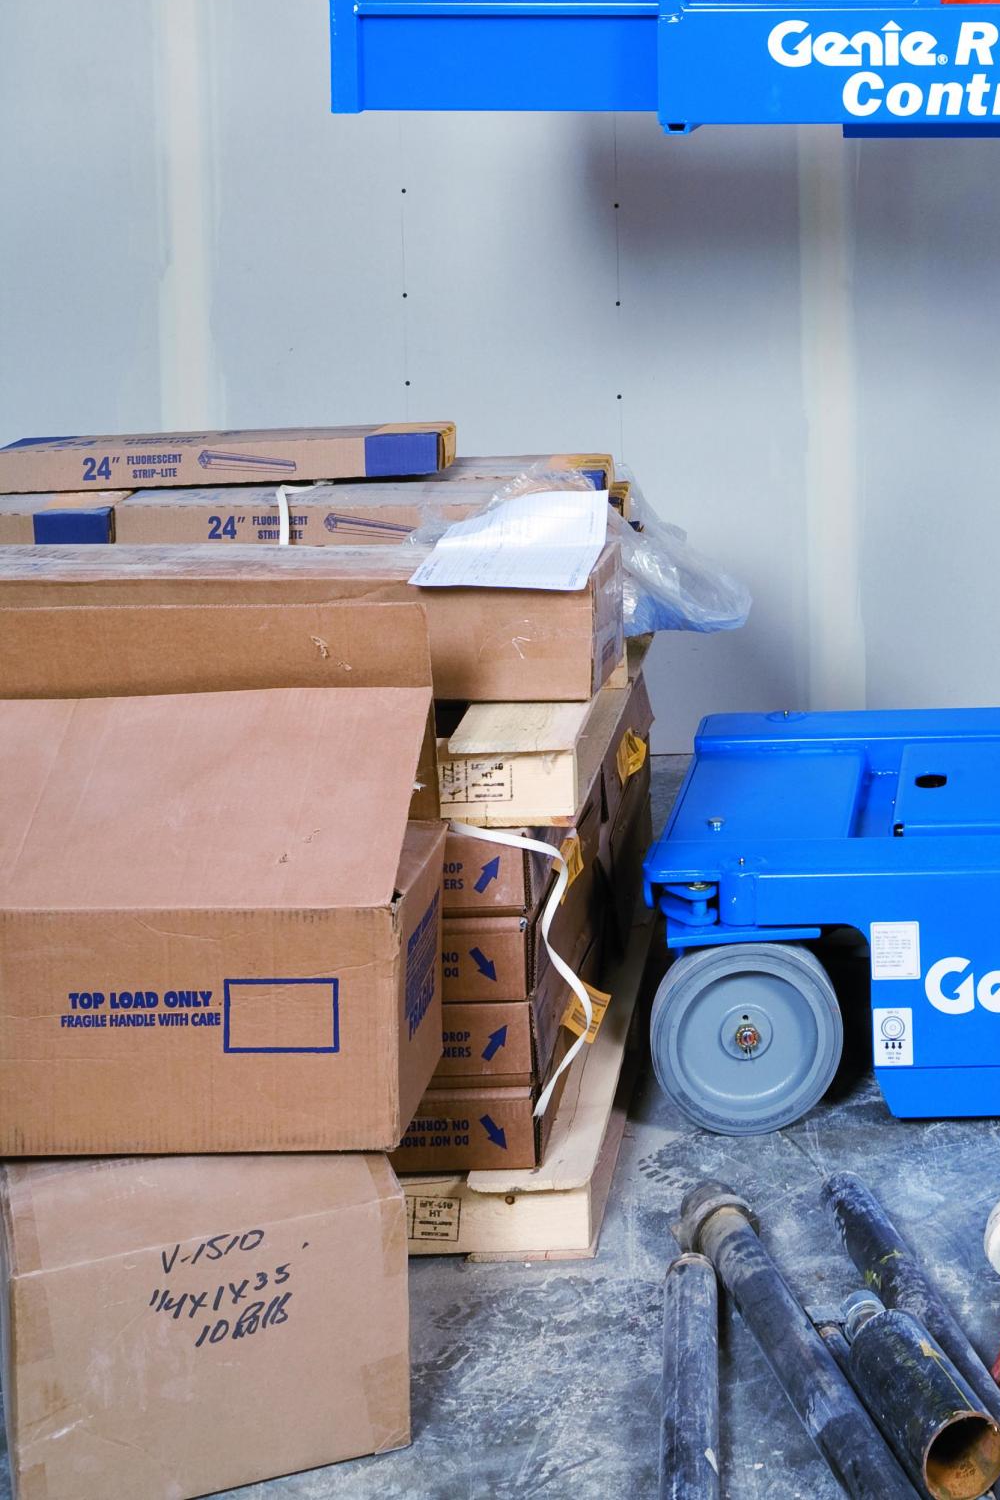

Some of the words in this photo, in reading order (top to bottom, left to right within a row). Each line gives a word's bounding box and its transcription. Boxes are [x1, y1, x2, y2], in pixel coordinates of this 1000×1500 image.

[126, 453, 183, 466] FLUORESCENT
[132, 467, 178, 479] STRIP-LITE
[68, 992, 105, 1009] TOP
[109, 991, 159, 1009] LOAD
[163, 990, 213, 1008] ONLY
[60, 1014, 107, 1028] FRAGILE
[109, 1013, 156, 1027] HANDLE
[158, 1012, 189, 1027] WITH
[191, 1012, 221, 1026] CARE
[452, 1119, 469, 1131] ON
[430, 1135, 451, 1147] NOT
[454, 1134, 469, 1146] DO
[162, 1229, 265, 1274] V-1510
[195, 1319, 230, 1348] 10
